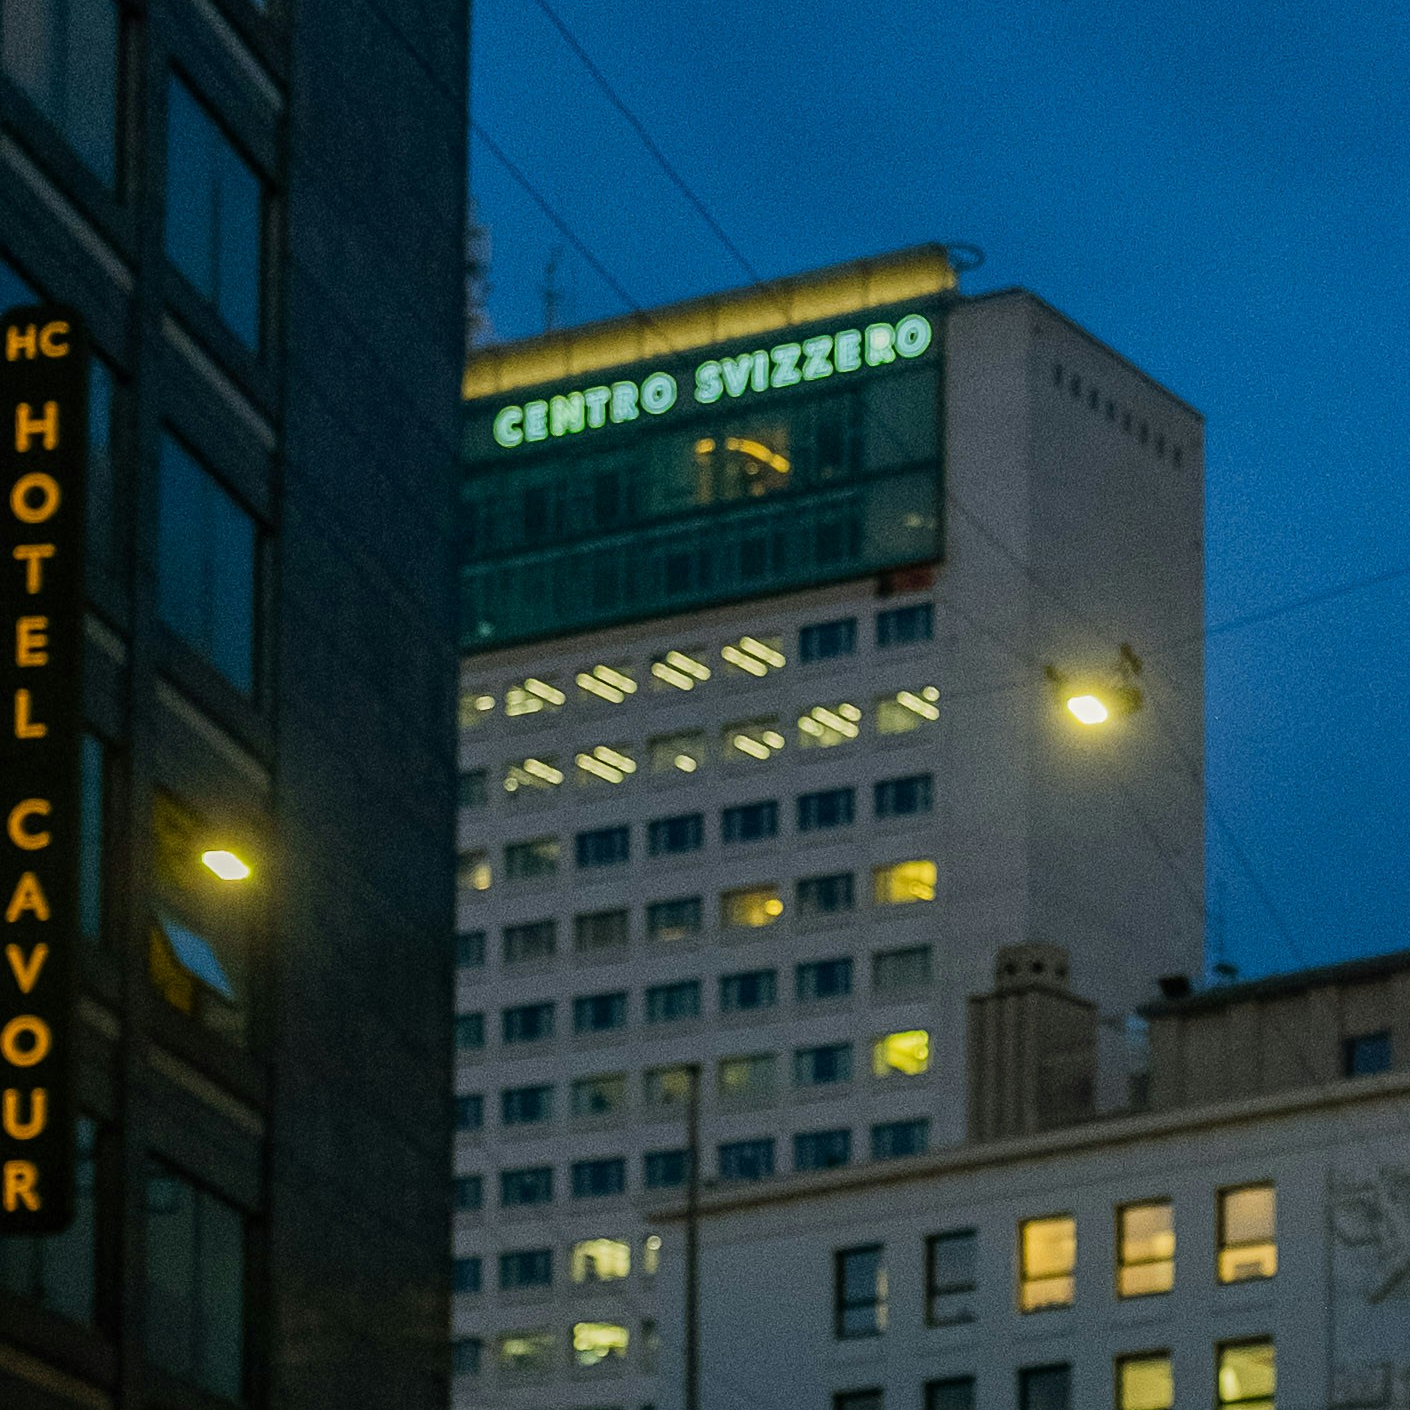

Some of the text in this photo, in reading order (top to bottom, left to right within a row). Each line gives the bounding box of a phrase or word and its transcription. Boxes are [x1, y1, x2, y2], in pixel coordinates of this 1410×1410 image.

[5, 320, 70, 362] HC
[493, 313, 933, 448] CENTRO SVIZZERO
[0, 400, 60, 1213] HOTEL CAVOUR
